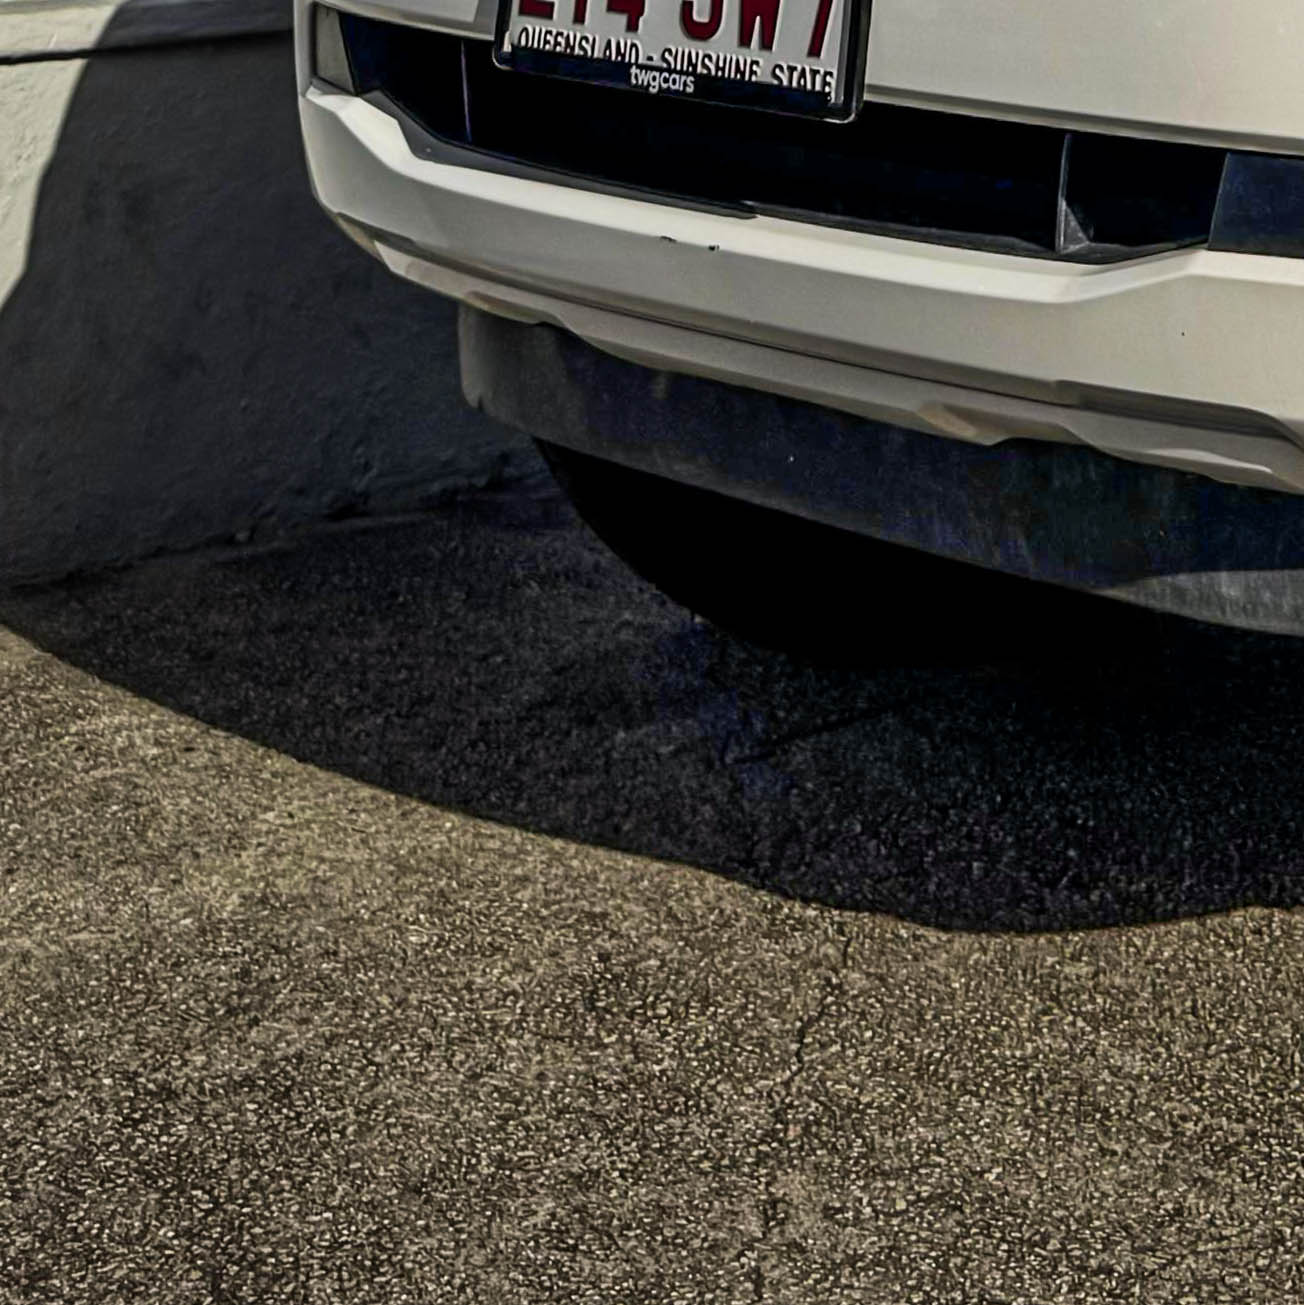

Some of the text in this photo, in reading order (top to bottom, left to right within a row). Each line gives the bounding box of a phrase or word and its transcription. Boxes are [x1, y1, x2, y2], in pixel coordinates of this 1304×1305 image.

[518, 25, 641, 65] QUEENSLAND
[661, 46, 761, 83] SUNSHINE
[771, 63, 835, 95] STATE
[629, 65, 695, 95] twgcars
